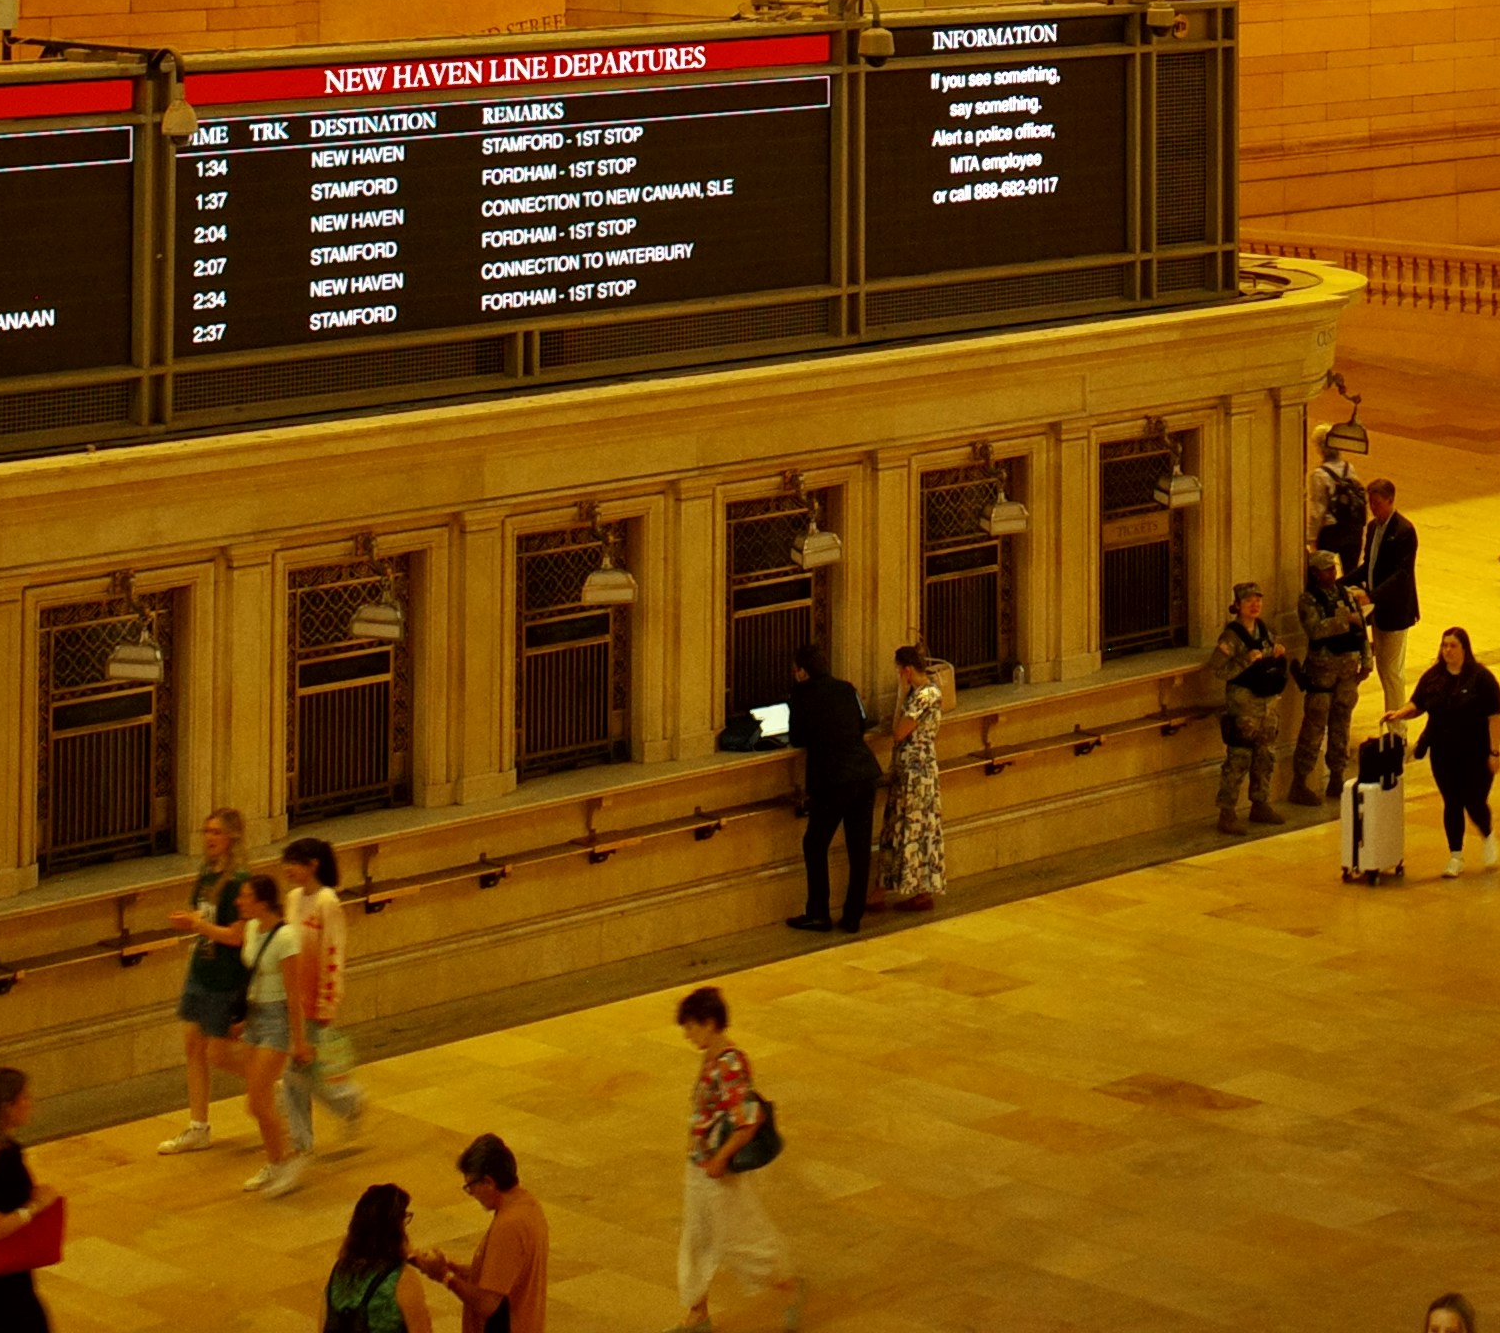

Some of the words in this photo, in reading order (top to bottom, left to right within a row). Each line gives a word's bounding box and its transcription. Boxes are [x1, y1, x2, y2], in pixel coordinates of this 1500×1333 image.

[932, 24, 1057, 50] INFORMATION
[324, 67, 387, 93] NEW
[393, 61, 483, 88] HAVEN
[489, 57, 548, 82] LINE
[553, 46, 706, 78] DEPARTURES
[931, 73, 940, 89] If
[942, 75, 966, 93] you
[968, 73, 992, 87] see
[994, 66, 1060, 85] something,
[482, 102, 564, 124] REMARKS
[950, 103, 973, 119] say
[975, 95, 1042, 115] something.
[188, 126, 229, 147] IME
[249, 122, 289, 141] TRK
[310, 112, 436, 137] DESTINATION
[932, 129, 962, 147] Alert
[964, 131, 974, 144] a
[976, 126, 1013, 147] police
[1015, 122, 1055, 140] officer,
[482, 133, 564, 155] STAMFORD
[575, 130, 602, 146] 1ST
[604, 126, 643, 145] STOP
[196, 159, 228, 177] 1:34
[311, 150, 349, 168] NEW
[352, 145, 404, 165] HAVEN
[950, 155, 980, 173] MTA
[982, 152, 1042, 172] employee
[482, 164, 556, 185] FORDHAM
[569, 161, 595, 178] 1ST
[597, 157, 636, 176] STOP
[196, 192, 228, 210] 1:37
[311, 178, 398, 201] STAMFORD
[933, 190, 947, 204] or
[949, 185, 971, 202] call
[974, 177, 1058, 200] 888-682-9117
